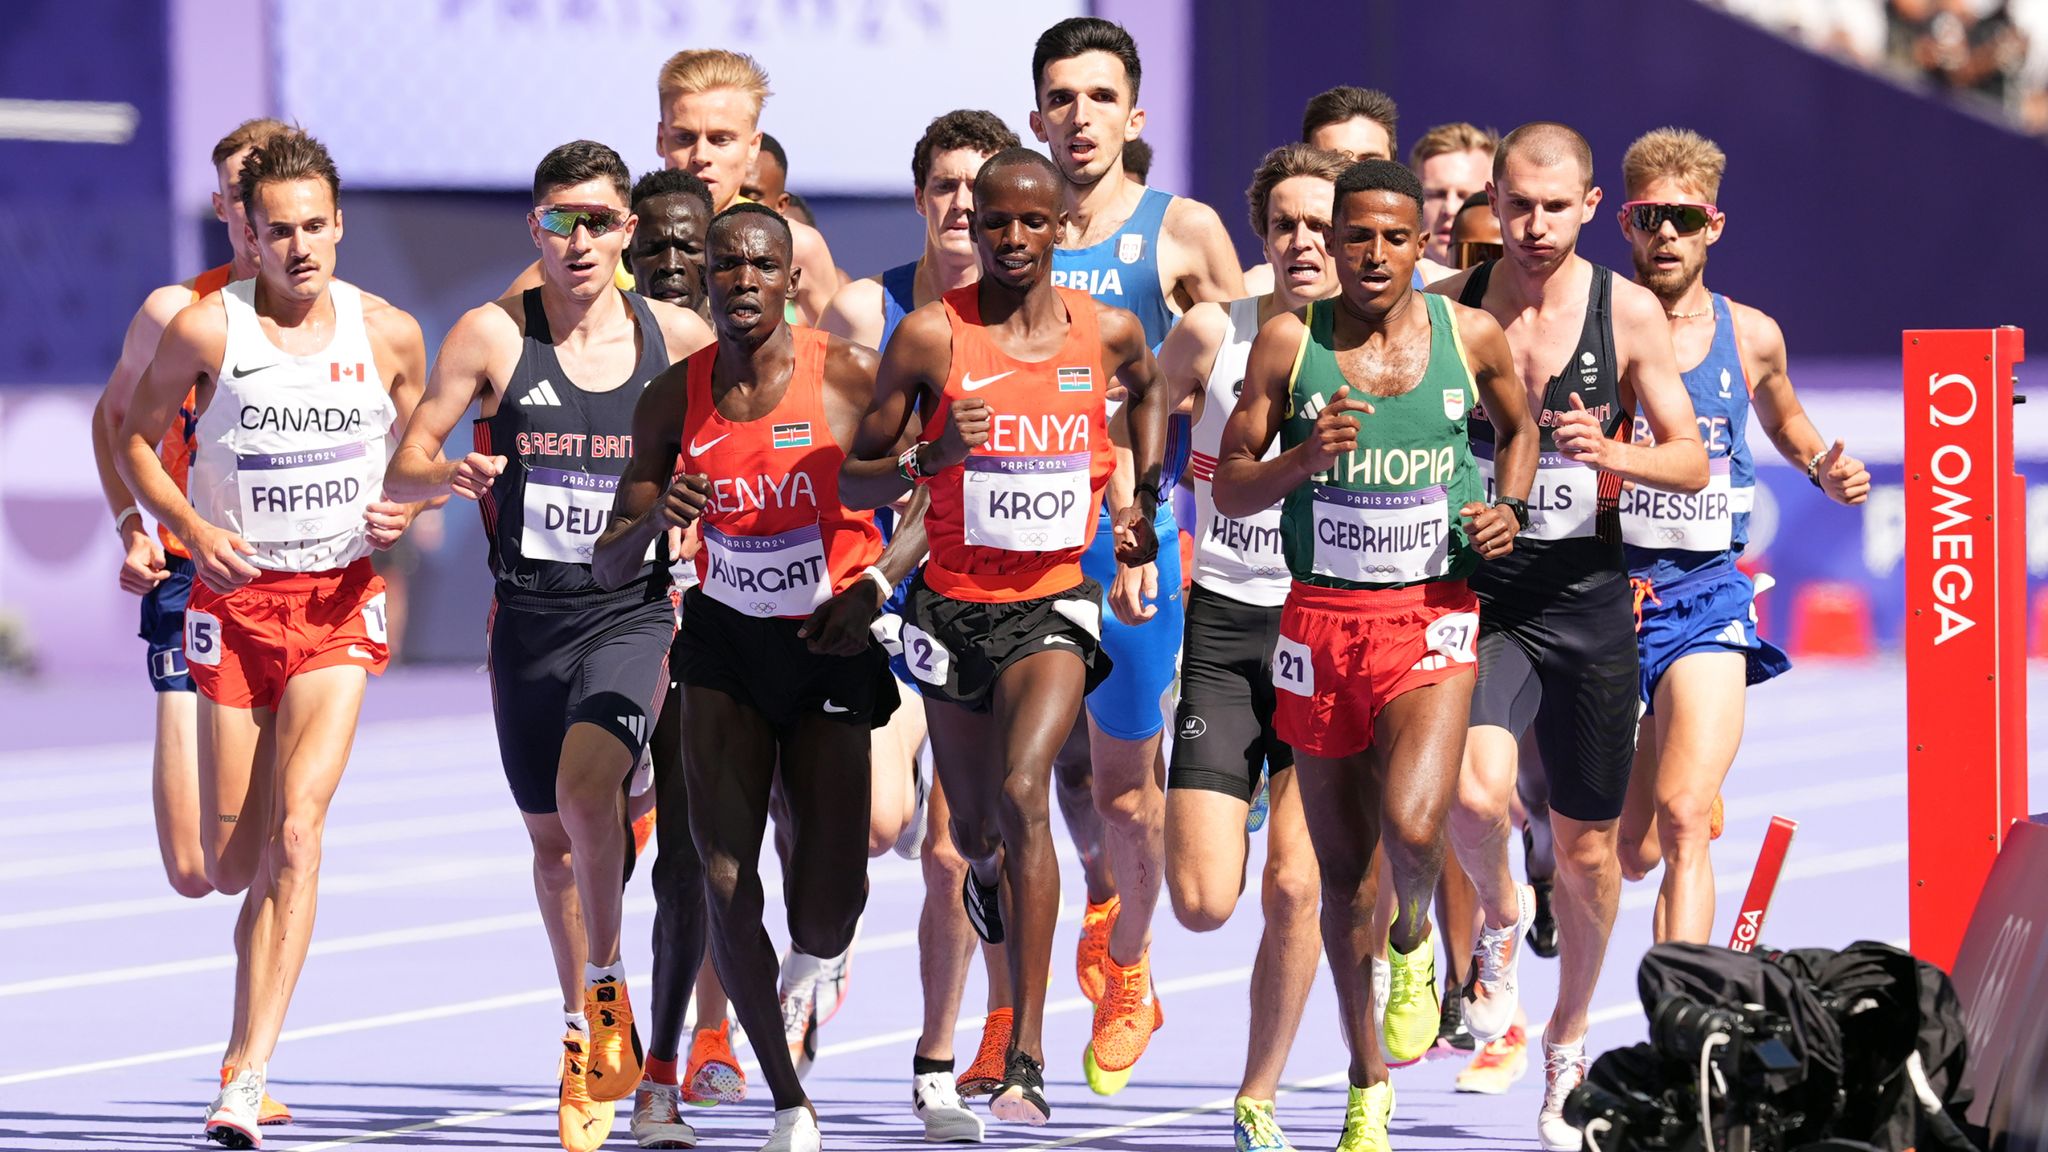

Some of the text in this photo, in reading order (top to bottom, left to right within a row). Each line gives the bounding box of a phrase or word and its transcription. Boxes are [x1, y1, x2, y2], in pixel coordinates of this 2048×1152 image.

[1051, 268, 1123, 295] RBIA
[240, 405, 361, 432] CANADA
[270, 451, 337, 466] PARIS 2024
[516, 432, 634, 458] GREAT BRIT
[1000, 460, 1067, 470] PARIS 2024
[1538, 457, 1561, 465] 024
[251, 477, 360, 513] FAFARD
[562, 475, 596, 488] PARIS
[989, 490, 1075, 520] KROP
[1347, 495, 1416, 505] PARIS 2024
[1619, 489, 1729, 521] GRESSIER
[722, 537, 786, 549] PARIS 2024
[1210, 515, 1284, 555] HEYM
[1318, 518, 1443, 553] GEBRHIWET
[1930, 444, 1977, 646] OMEGA
[711, 552, 823, 593] KURGAT
[188, 621, 213, 654] 15
[1438, 625, 1469, 651] 21
[913, 638, 933, 672] 2
[1279, 650, 1304, 683] 21
[1731, 910, 1763, 954] EGA
